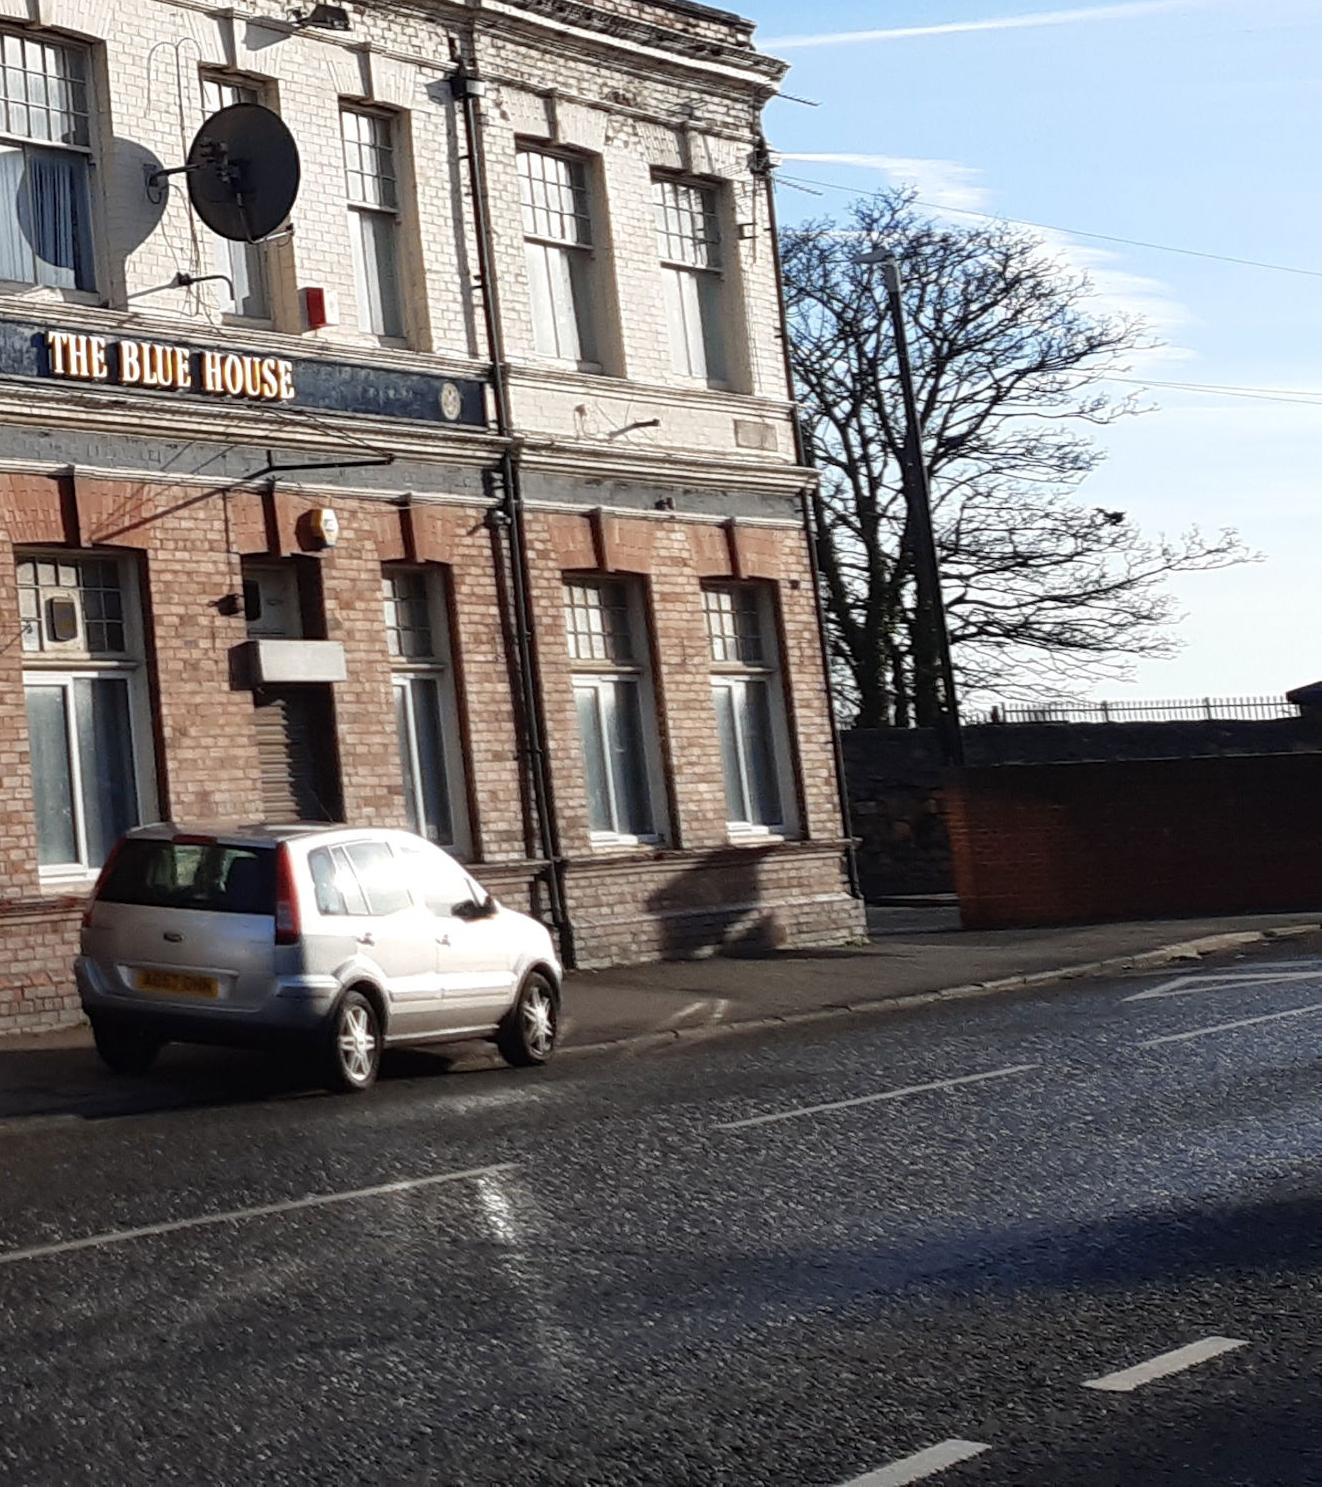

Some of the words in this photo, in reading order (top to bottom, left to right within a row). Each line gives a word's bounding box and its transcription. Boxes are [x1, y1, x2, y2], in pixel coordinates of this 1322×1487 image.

[47, 330, 108, 379] THE
[119, 340, 192, 389] BLUE
[202, 350, 296, 400] HOUSE
